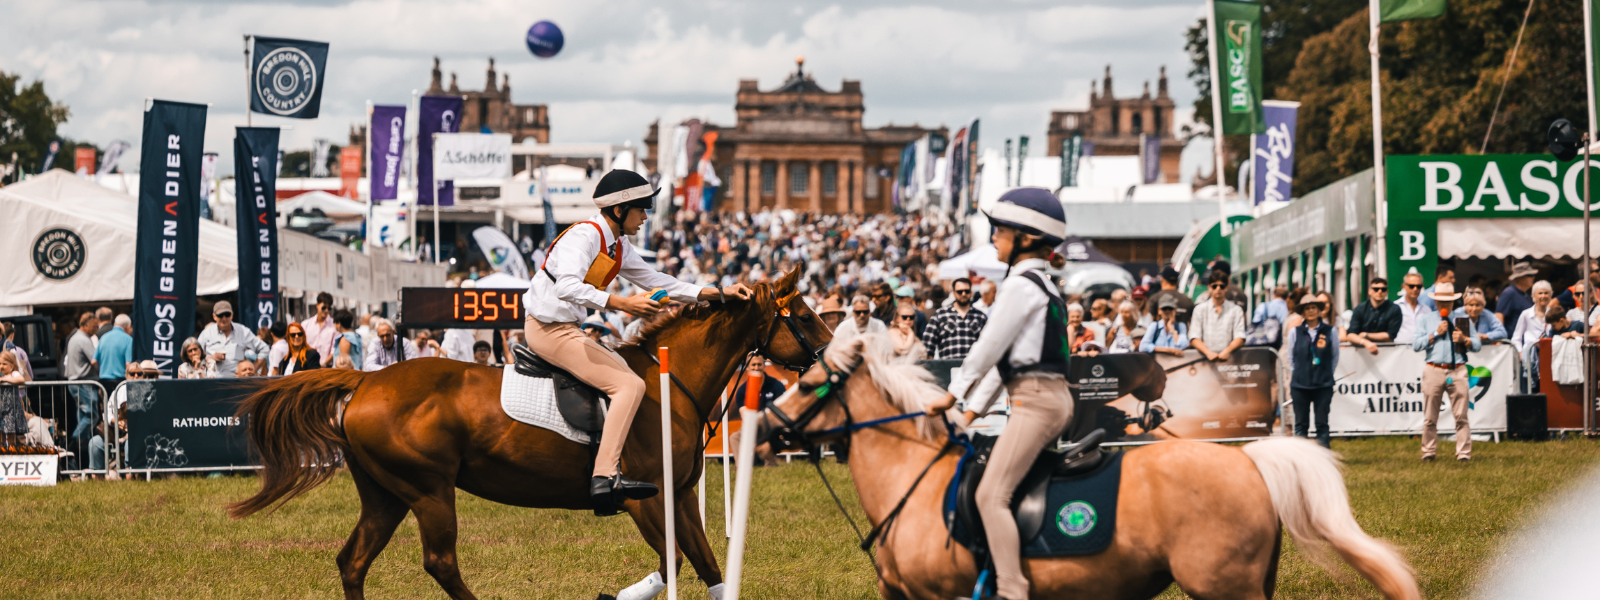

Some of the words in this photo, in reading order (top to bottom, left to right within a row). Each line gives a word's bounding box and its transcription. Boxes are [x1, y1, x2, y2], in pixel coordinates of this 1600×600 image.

[262, 52, 299, 75] BREDON
[299, 59, 311, 81] HILL
[1230, 49, 1247, 107] BASC
[263, 91, 306, 110] COUNTRY
[1419, 160, 1600, 212] BASC
[160, 134, 180, 292] GRENADIER
[38, 231, 66, 253] BREDON
[41, 259, 79, 276] COUNTRY
[1333, 377, 1422, 395] ountrysi
[1363, 396, 1446, 413] Alliane
[172, 416, 240, 428] RATHBONES
[1, 461, 43, 476] YFIX
